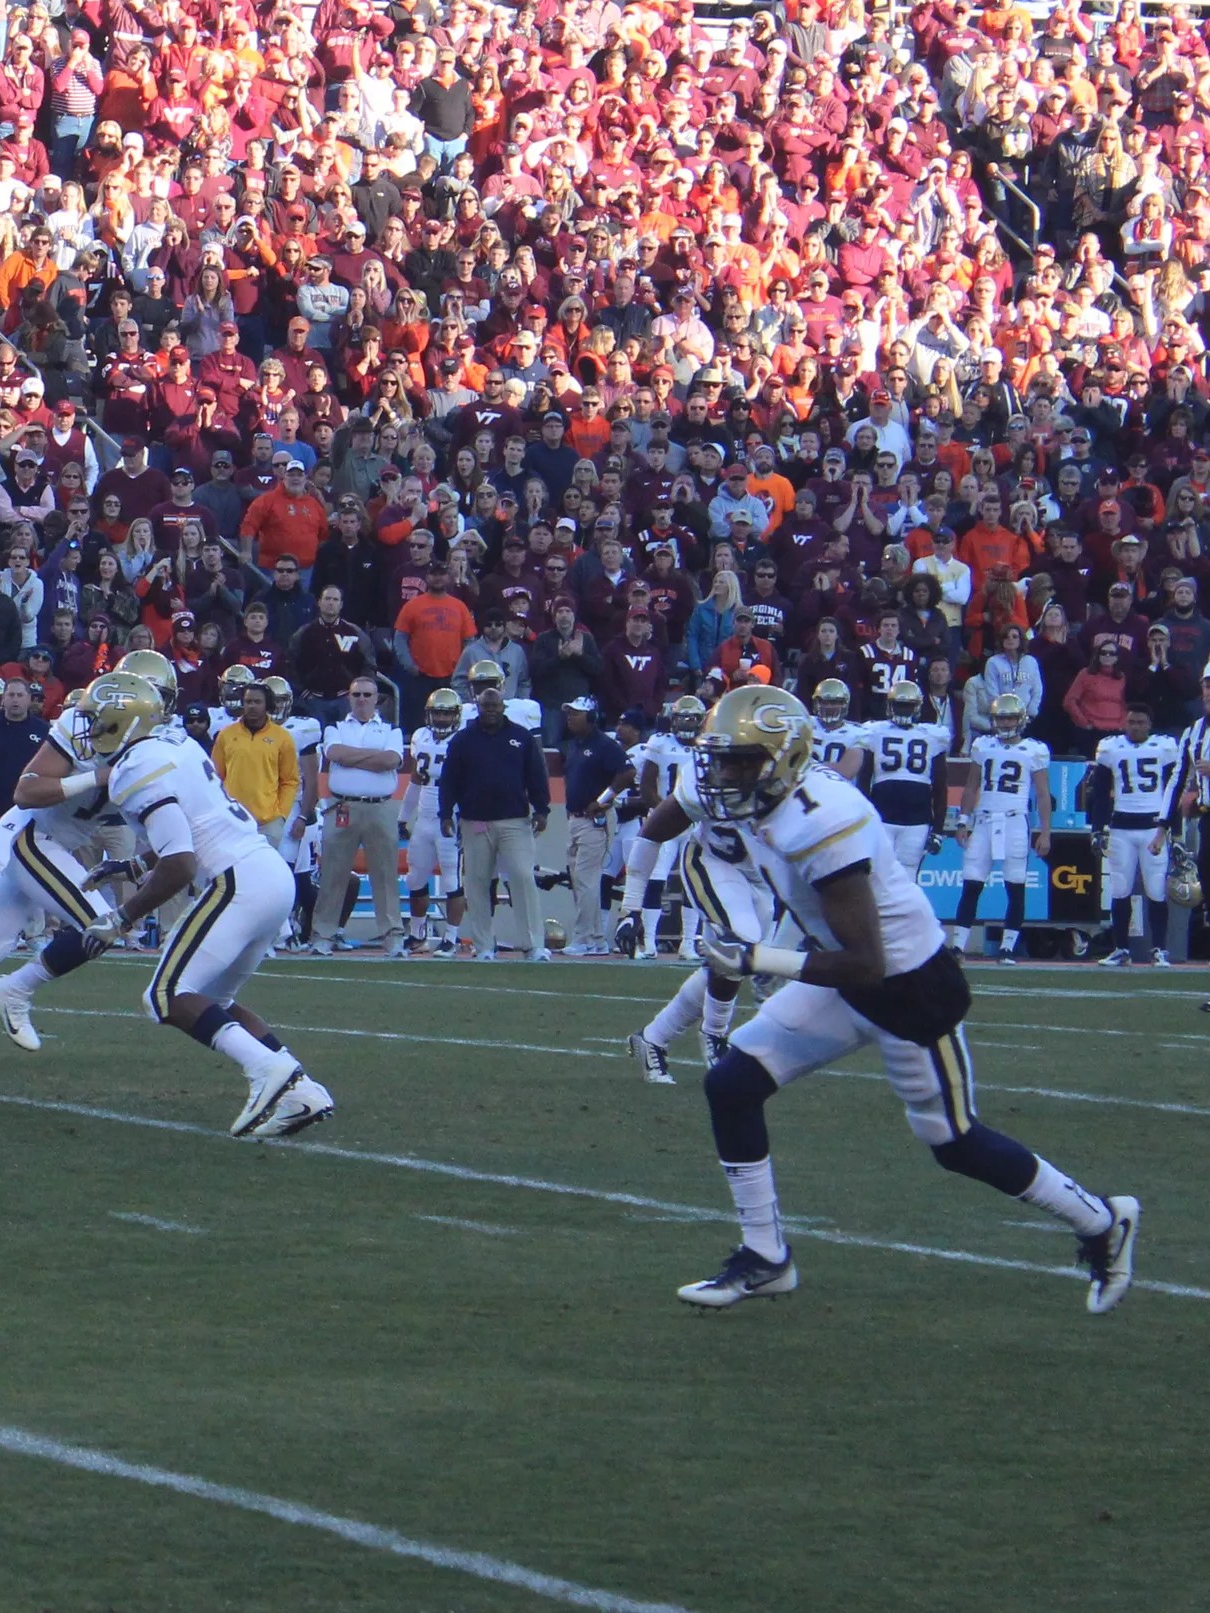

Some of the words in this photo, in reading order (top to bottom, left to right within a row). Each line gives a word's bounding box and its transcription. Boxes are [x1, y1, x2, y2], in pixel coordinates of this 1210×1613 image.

[164, 107, 193, 124] VT
[475, 411, 501, 425] VT
[258, 476, 273, 484] VT
[793, 535, 812, 546] VT
[334, 634, 359, 652] VT
[625, 655, 651, 671] VT
[872, 663, 907, 693] 34
[91, 684, 137, 711] GT
[753, 703, 805, 740] GT
[881, 737, 928, 775] 58
[983, 758, 1023, 795] 12
[1118, 757, 1159, 795] 15
[793, 787, 821, 815] 1
[916, 869, 1040, 888] OWEAE
[1052, 865, 1093, 895] GT
